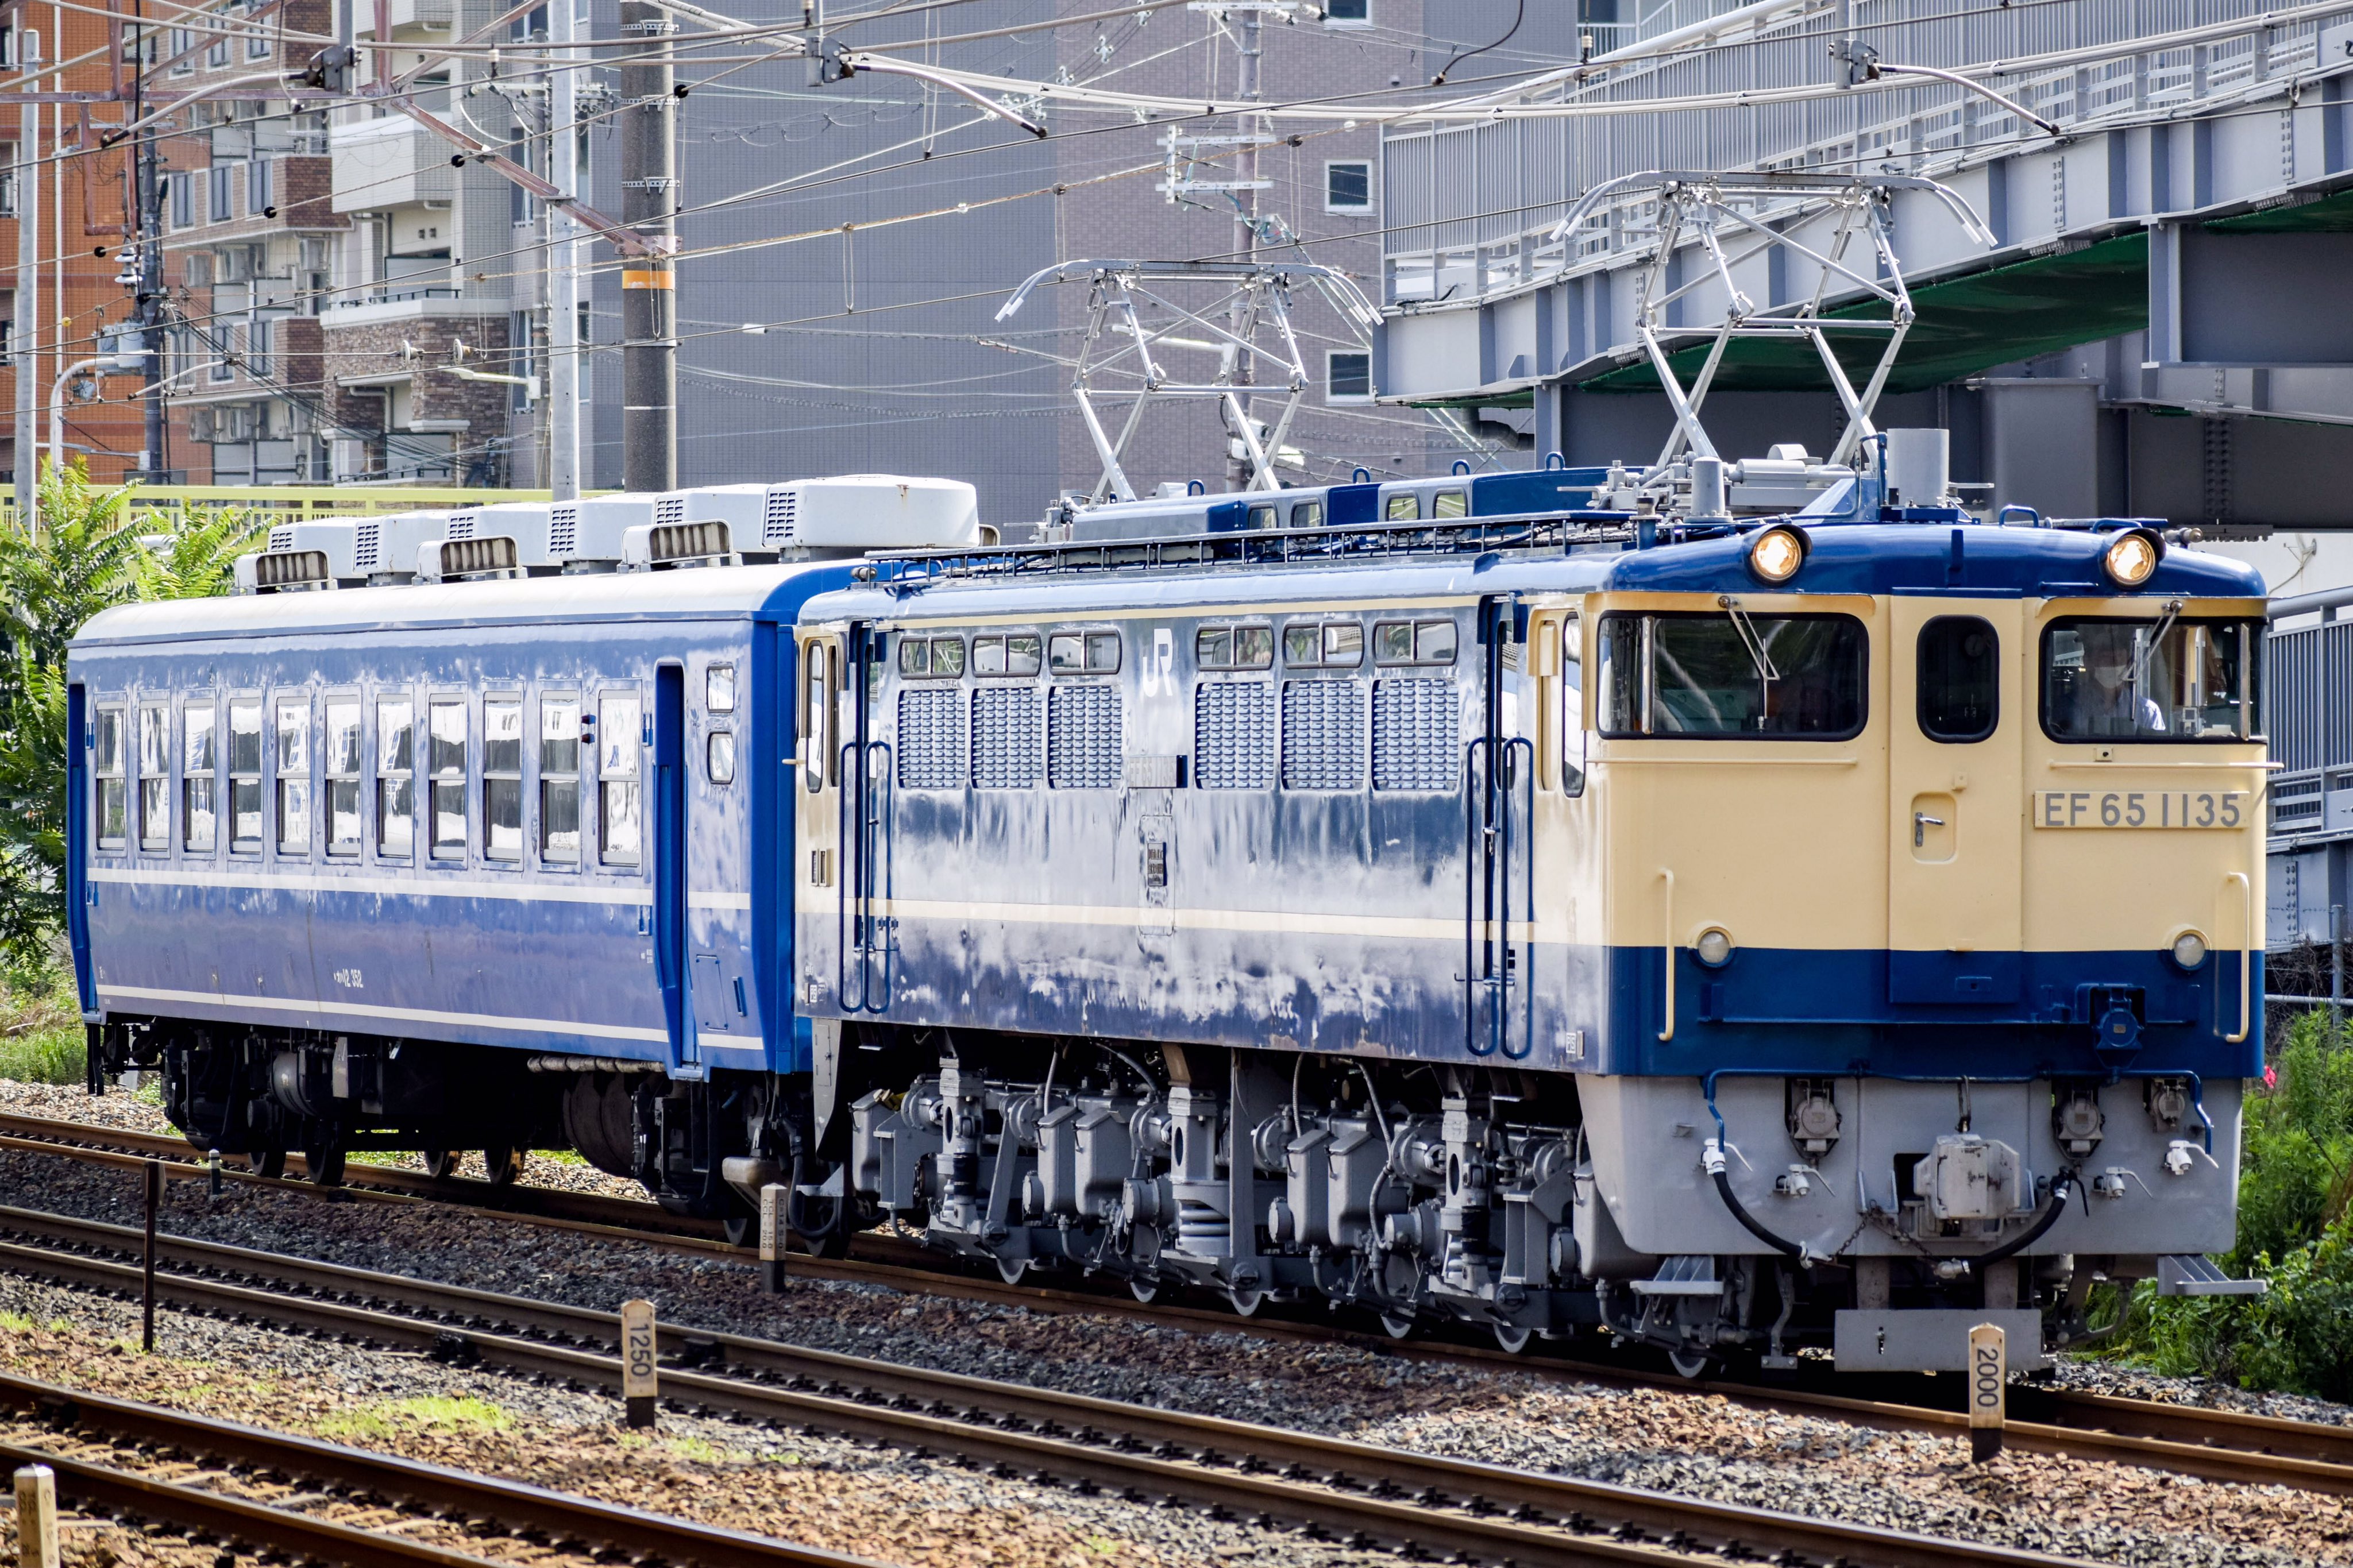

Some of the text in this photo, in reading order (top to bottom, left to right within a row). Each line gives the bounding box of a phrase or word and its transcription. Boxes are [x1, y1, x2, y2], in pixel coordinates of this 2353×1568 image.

[1143, 628, 1173, 697] JR
[2162, 793, 2239, 827] 1135
[630, 1323, 651, 1377] 1250
[1977, 1348, 1999, 1407] 2000
